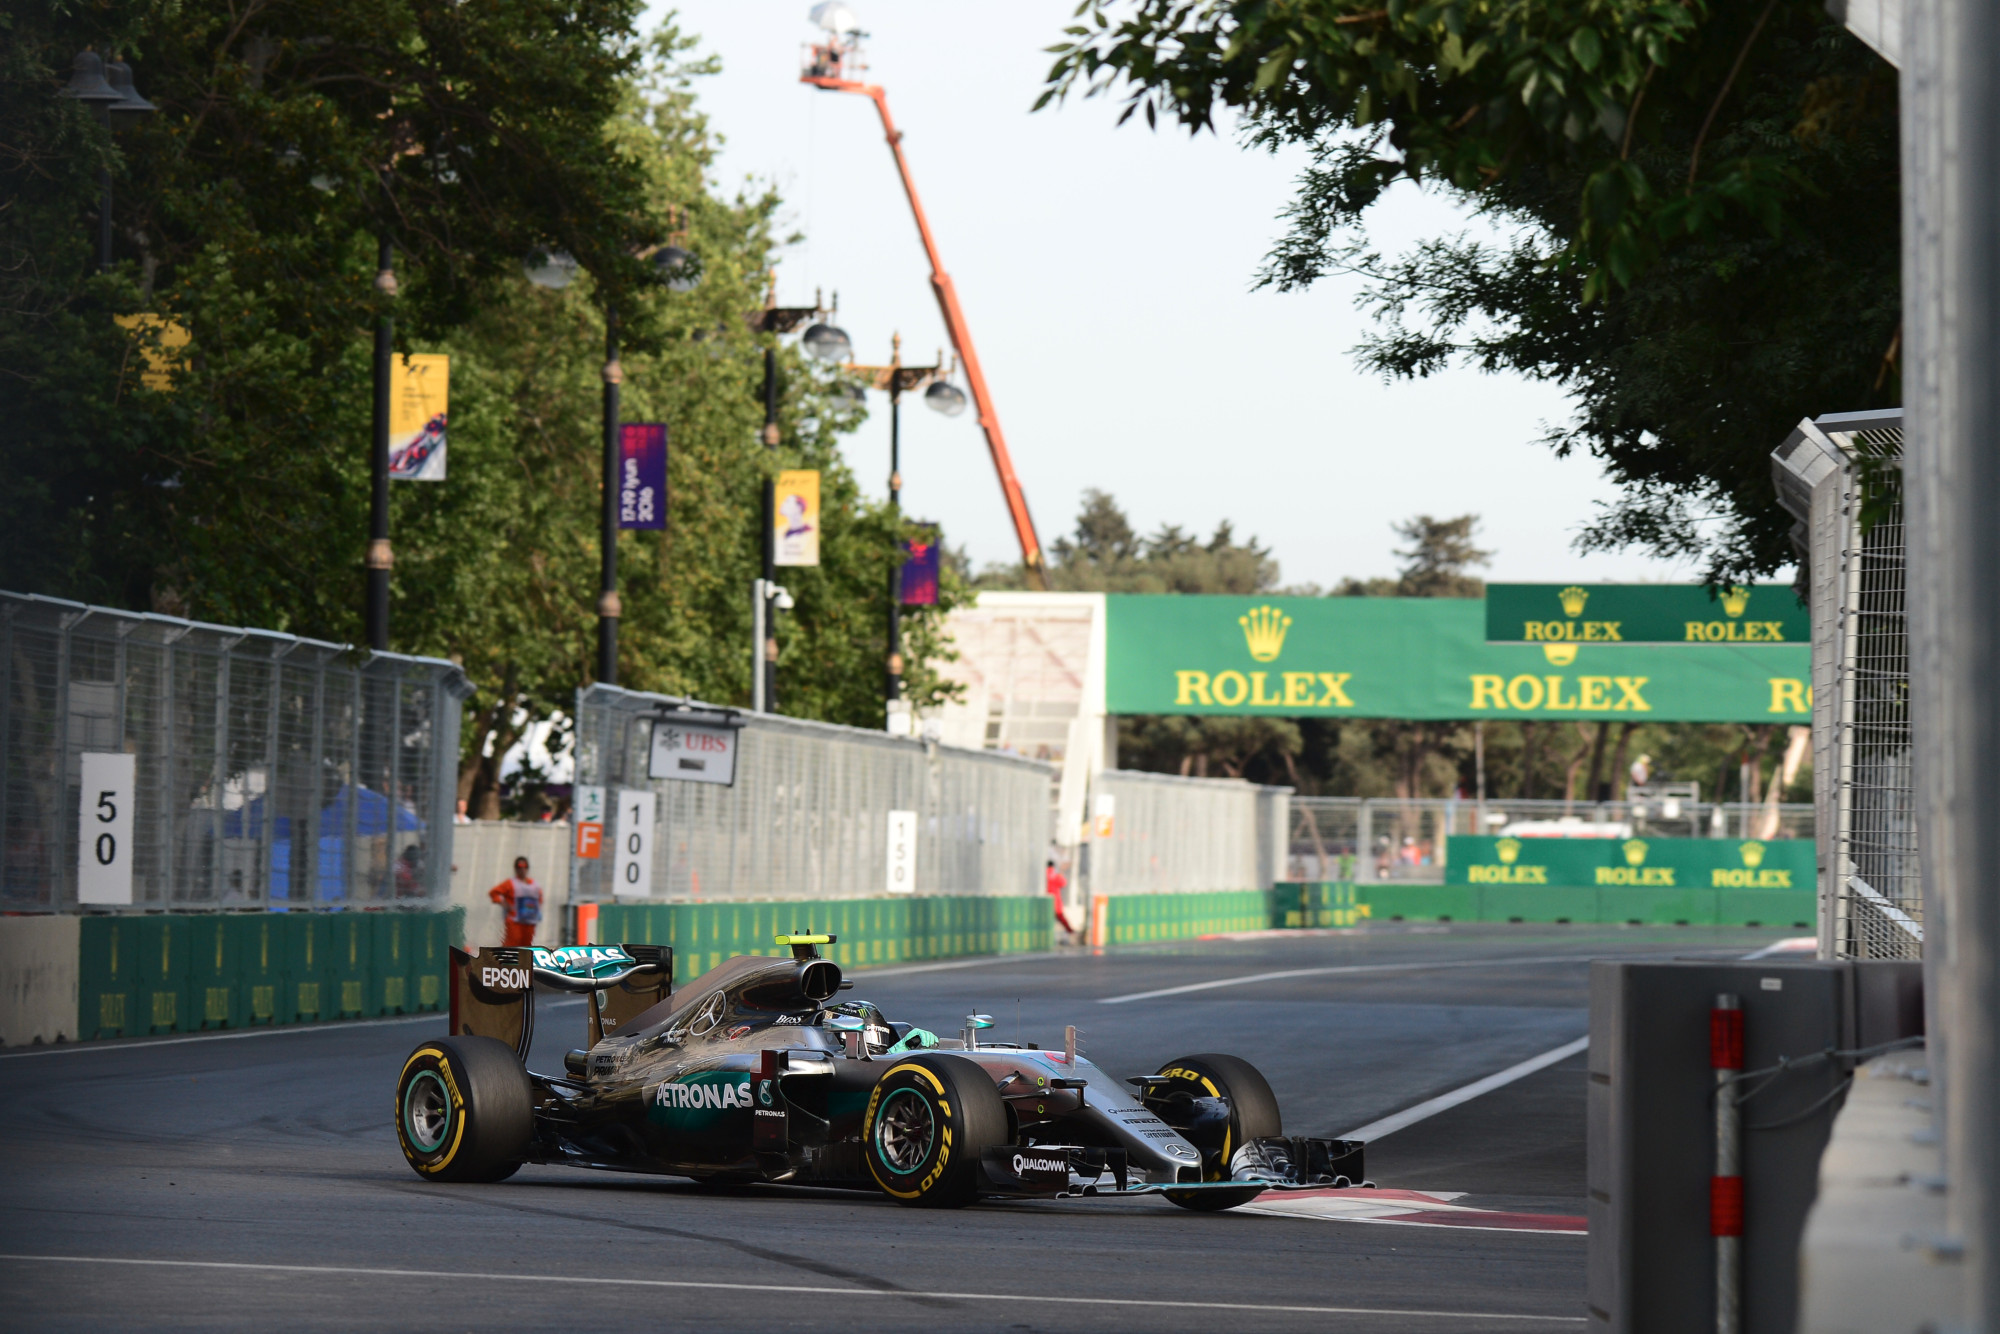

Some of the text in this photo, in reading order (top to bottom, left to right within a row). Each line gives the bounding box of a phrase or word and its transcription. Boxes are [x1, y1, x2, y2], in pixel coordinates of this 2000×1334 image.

[638, 486, 654, 522] 2016
[1524, 621, 1622, 641] ROLEX
[1685, 621, 1784, 641] ROLEX
[1175, 670, 1355, 707] ROLEX
[1469, 674, 1652, 711] ROLEX
[1767, 678, 1812, 713] R
[685, 732, 727, 752] UBS
[96, 790, 117, 866] 50
[580, 826, 600, 854] F
[626, 803, 641, 884] 100
[895, 821, 906, 882] 150
[1468, 865, 1547, 884] ROLEX
[1595, 867, 1675, 886] ROLEX
[1712, 869, 1792, 888] ROLEX
[533, 949, 626, 968] RONAS
[482, 967, 530, 989] EPSON
[656, 1082, 754, 1109] PETRONAS
[755, 1109, 786, 1118] PETRONAS
[920, 1124, 952, 1192] ZERO
[1012, 1153, 1066, 1176] QUALCOMM
